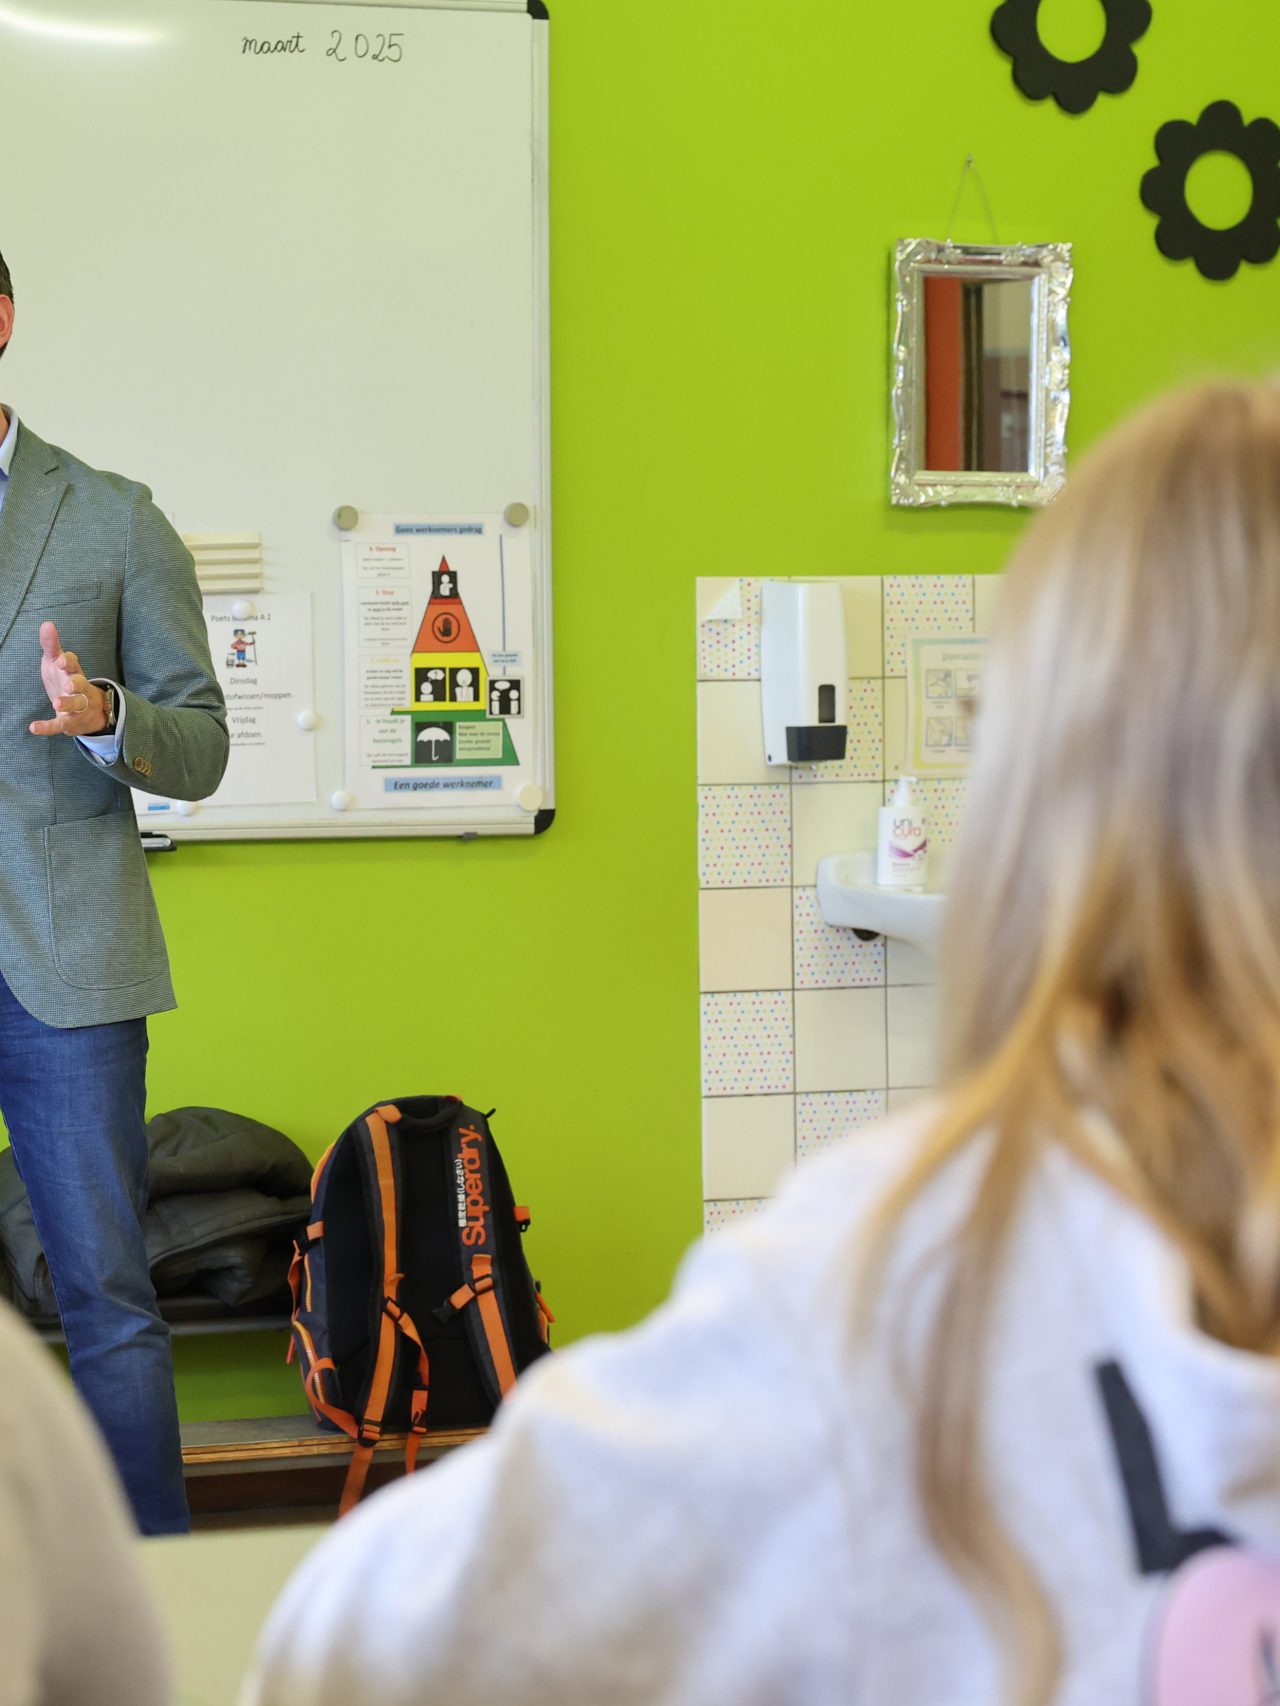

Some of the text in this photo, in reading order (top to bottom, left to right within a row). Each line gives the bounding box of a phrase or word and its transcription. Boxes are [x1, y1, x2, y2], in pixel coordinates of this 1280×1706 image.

[242, 30, 404, 62] maart 2025
[230, 677, 258, 686] Dinsdag
[231, 715, 256, 725] Vrijdag
[394, 779, 493, 791] Een goede werknemer
